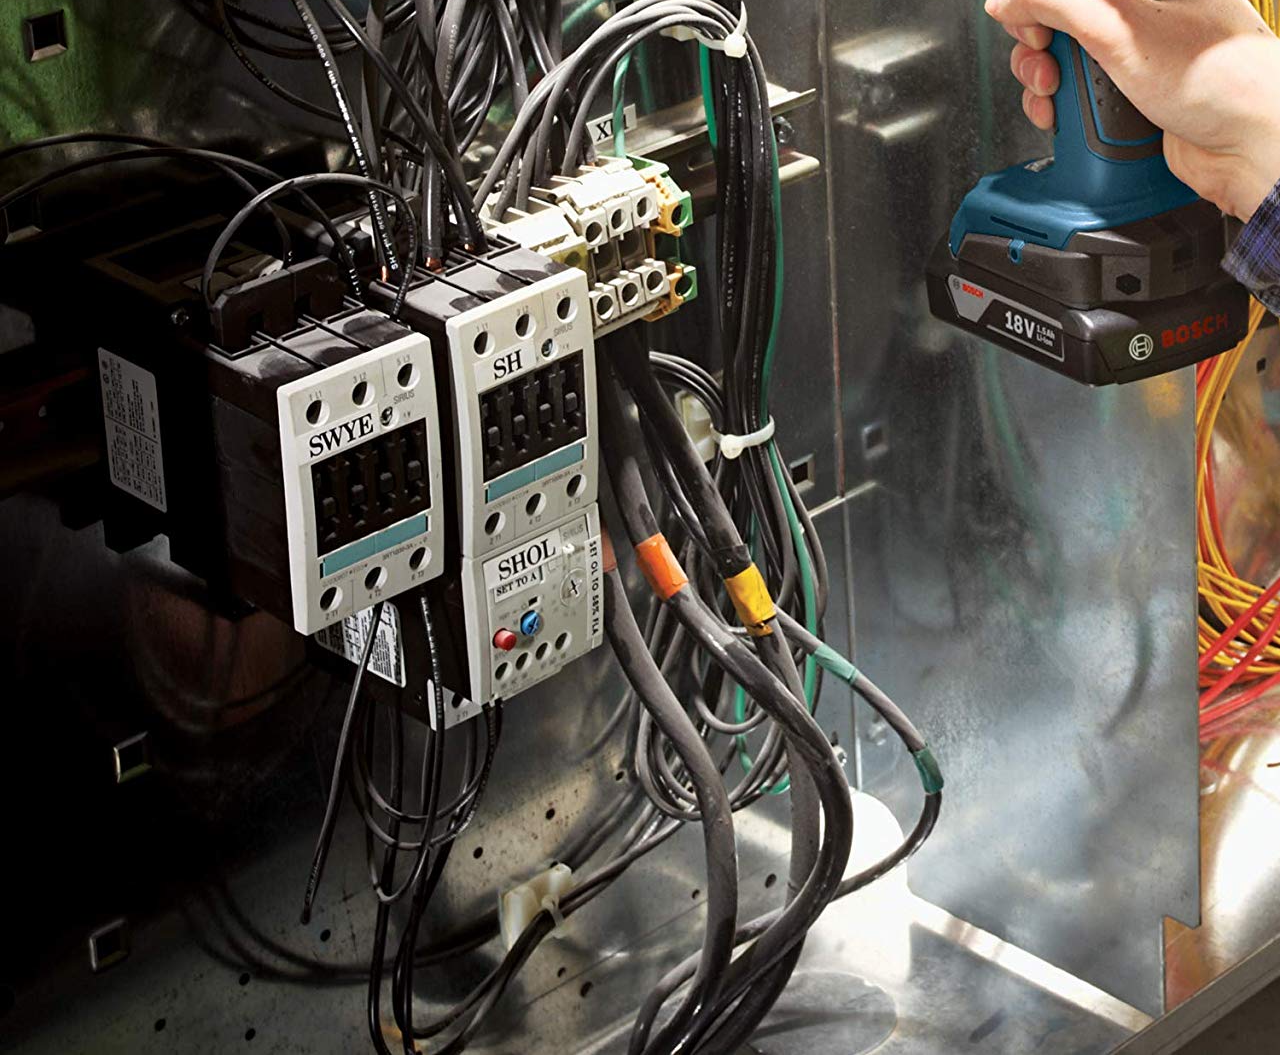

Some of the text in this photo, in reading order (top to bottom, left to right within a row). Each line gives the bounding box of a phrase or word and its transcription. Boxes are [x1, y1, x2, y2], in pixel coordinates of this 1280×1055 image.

[962, 283, 984, 298] BOSCH
[1004, 310, 1035, 339] 18V
[1161, 312, 1229, 349] BOSCH
[493, 348, 523, 380] SH
[393, 389, 415, 405] SIRIUS
[308, 412, 374, 458] SWYE
[498, 538, 556, 581] SHOL
[589, 540, 598, 561] SET
[590, 562, 599, 575] OL
[496, 571, 537, 596] SET TO A
[591, 577, 599, 591] TO
[592, 618, 600, 636] FLA
